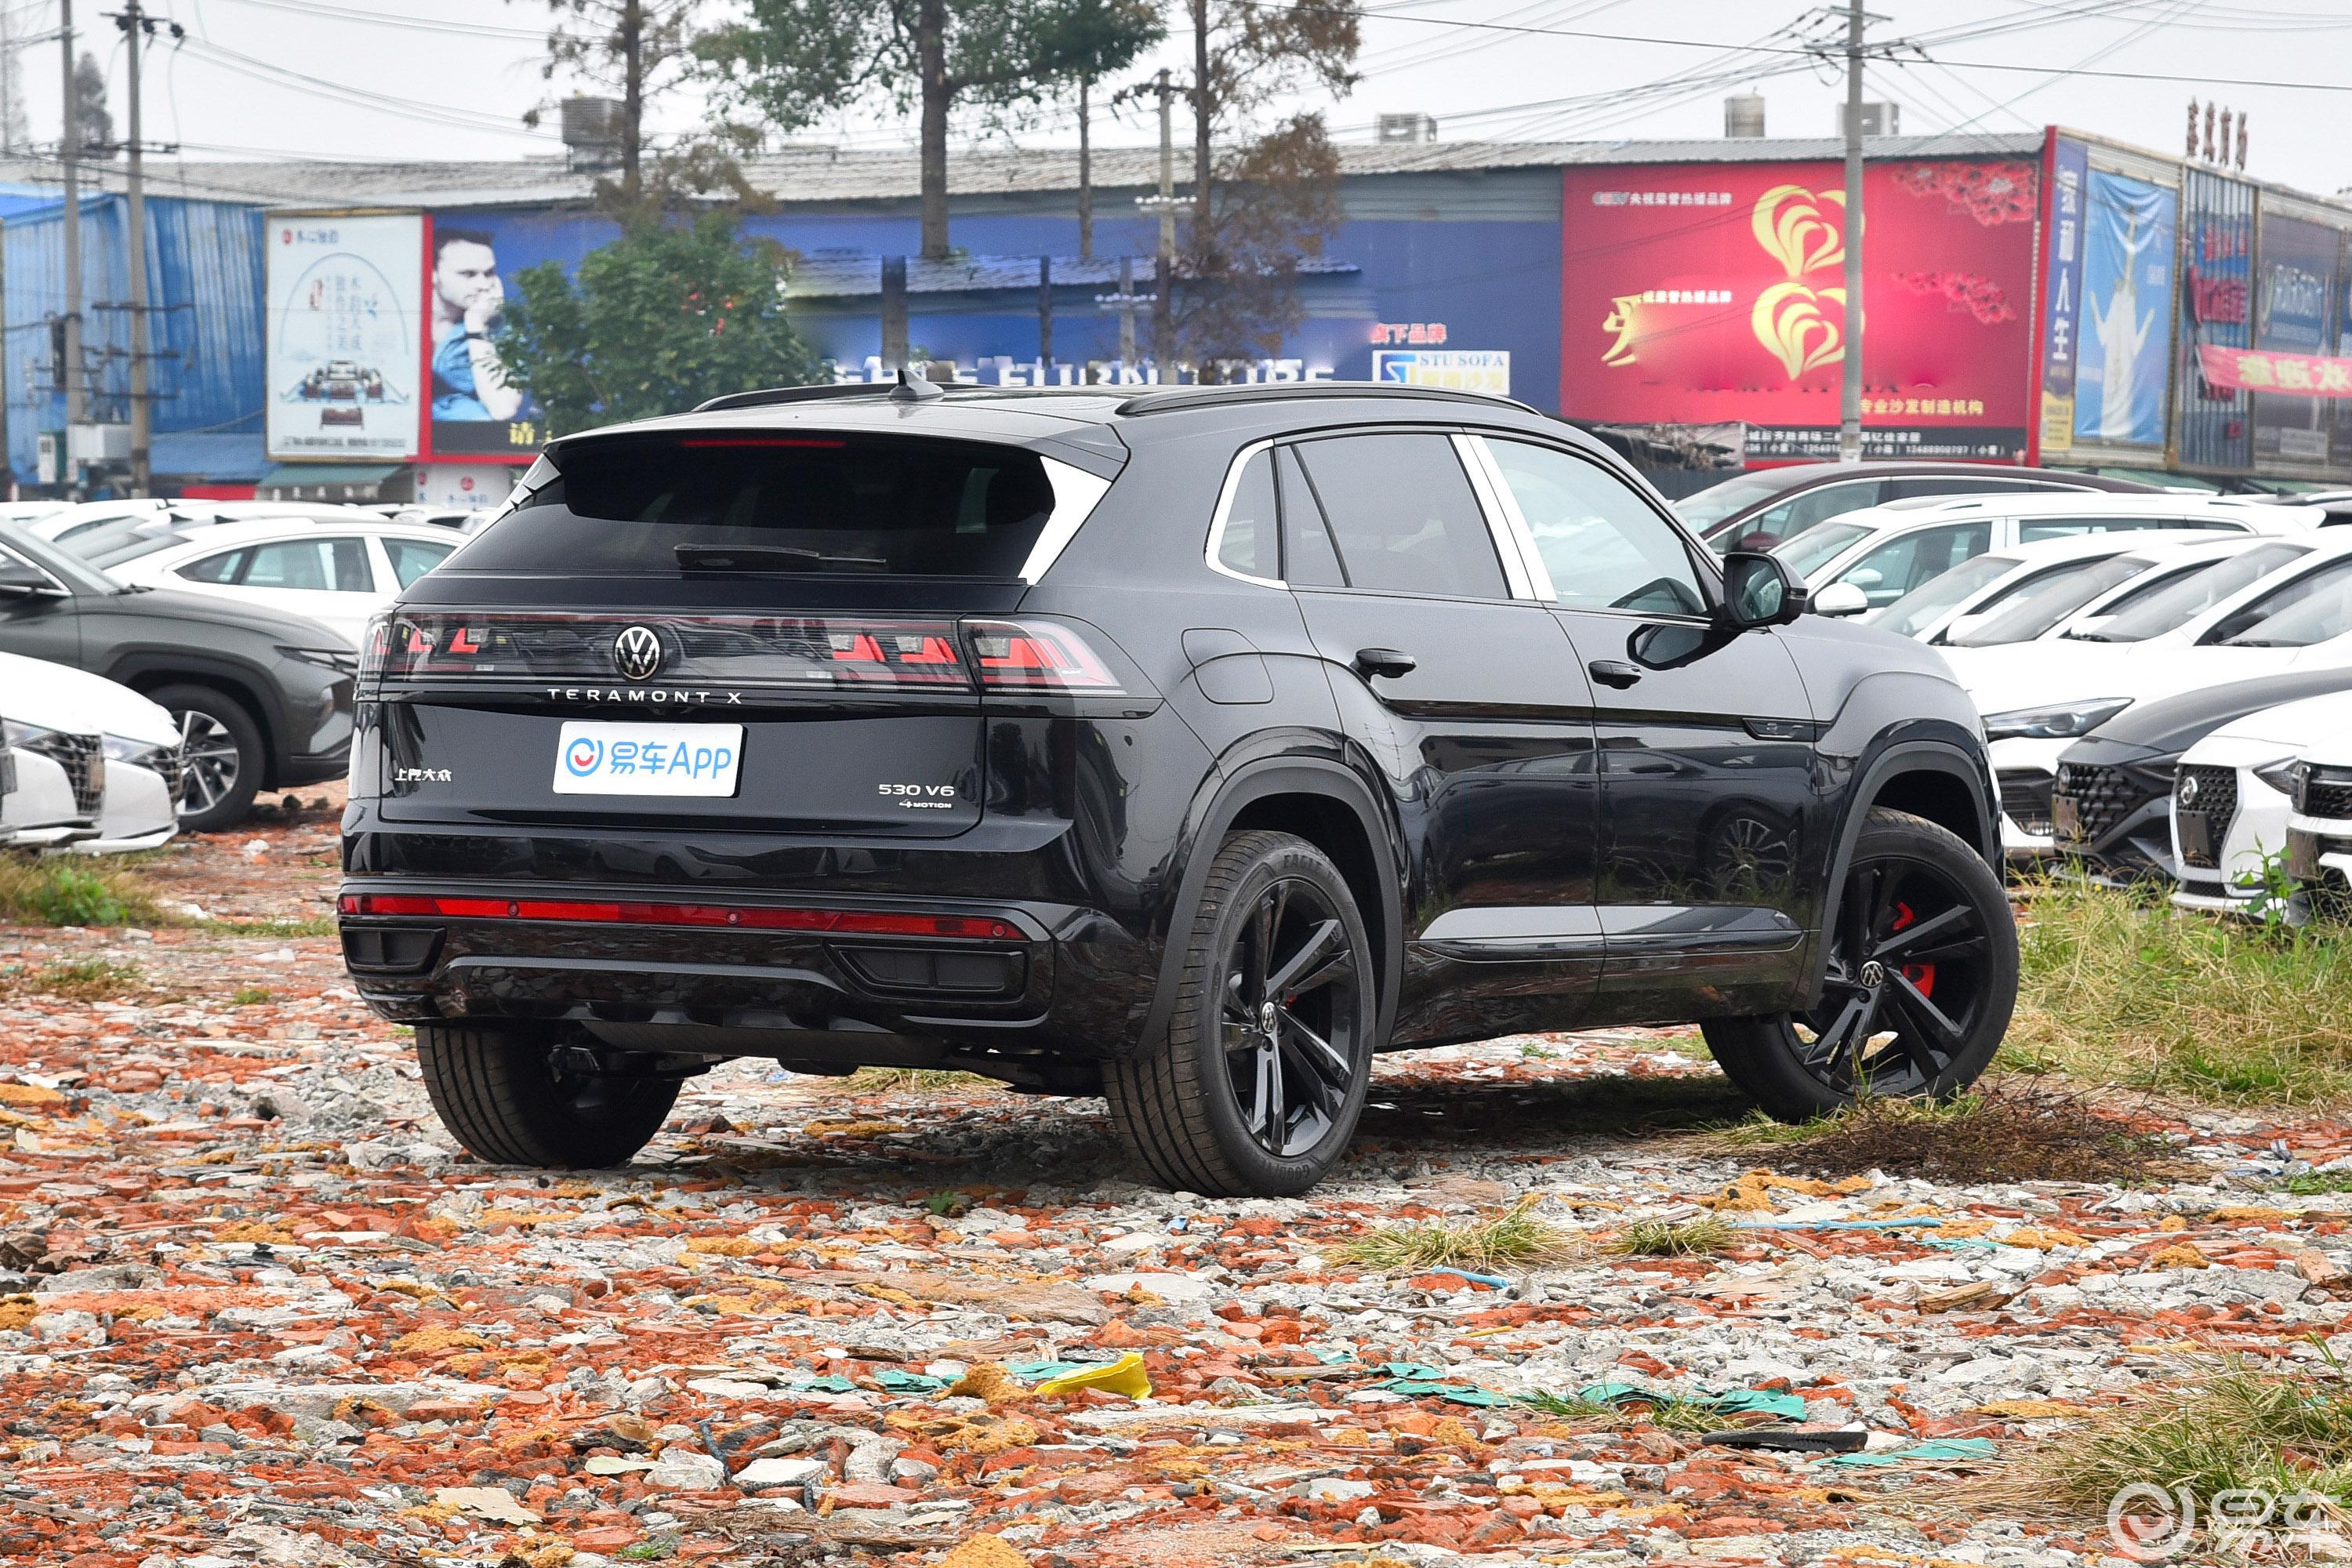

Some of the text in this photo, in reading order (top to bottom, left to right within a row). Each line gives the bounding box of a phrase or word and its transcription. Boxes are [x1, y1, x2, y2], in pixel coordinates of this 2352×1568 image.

[1457, 354, 1504, 367] SOFA
[547, 688, 742, 705] TERAMONT X
[394, 768, 452, 782] 上汽大众
[879, 784, 955, 797] 530 V6
[898, 799, 952, 809] 4MOTION
